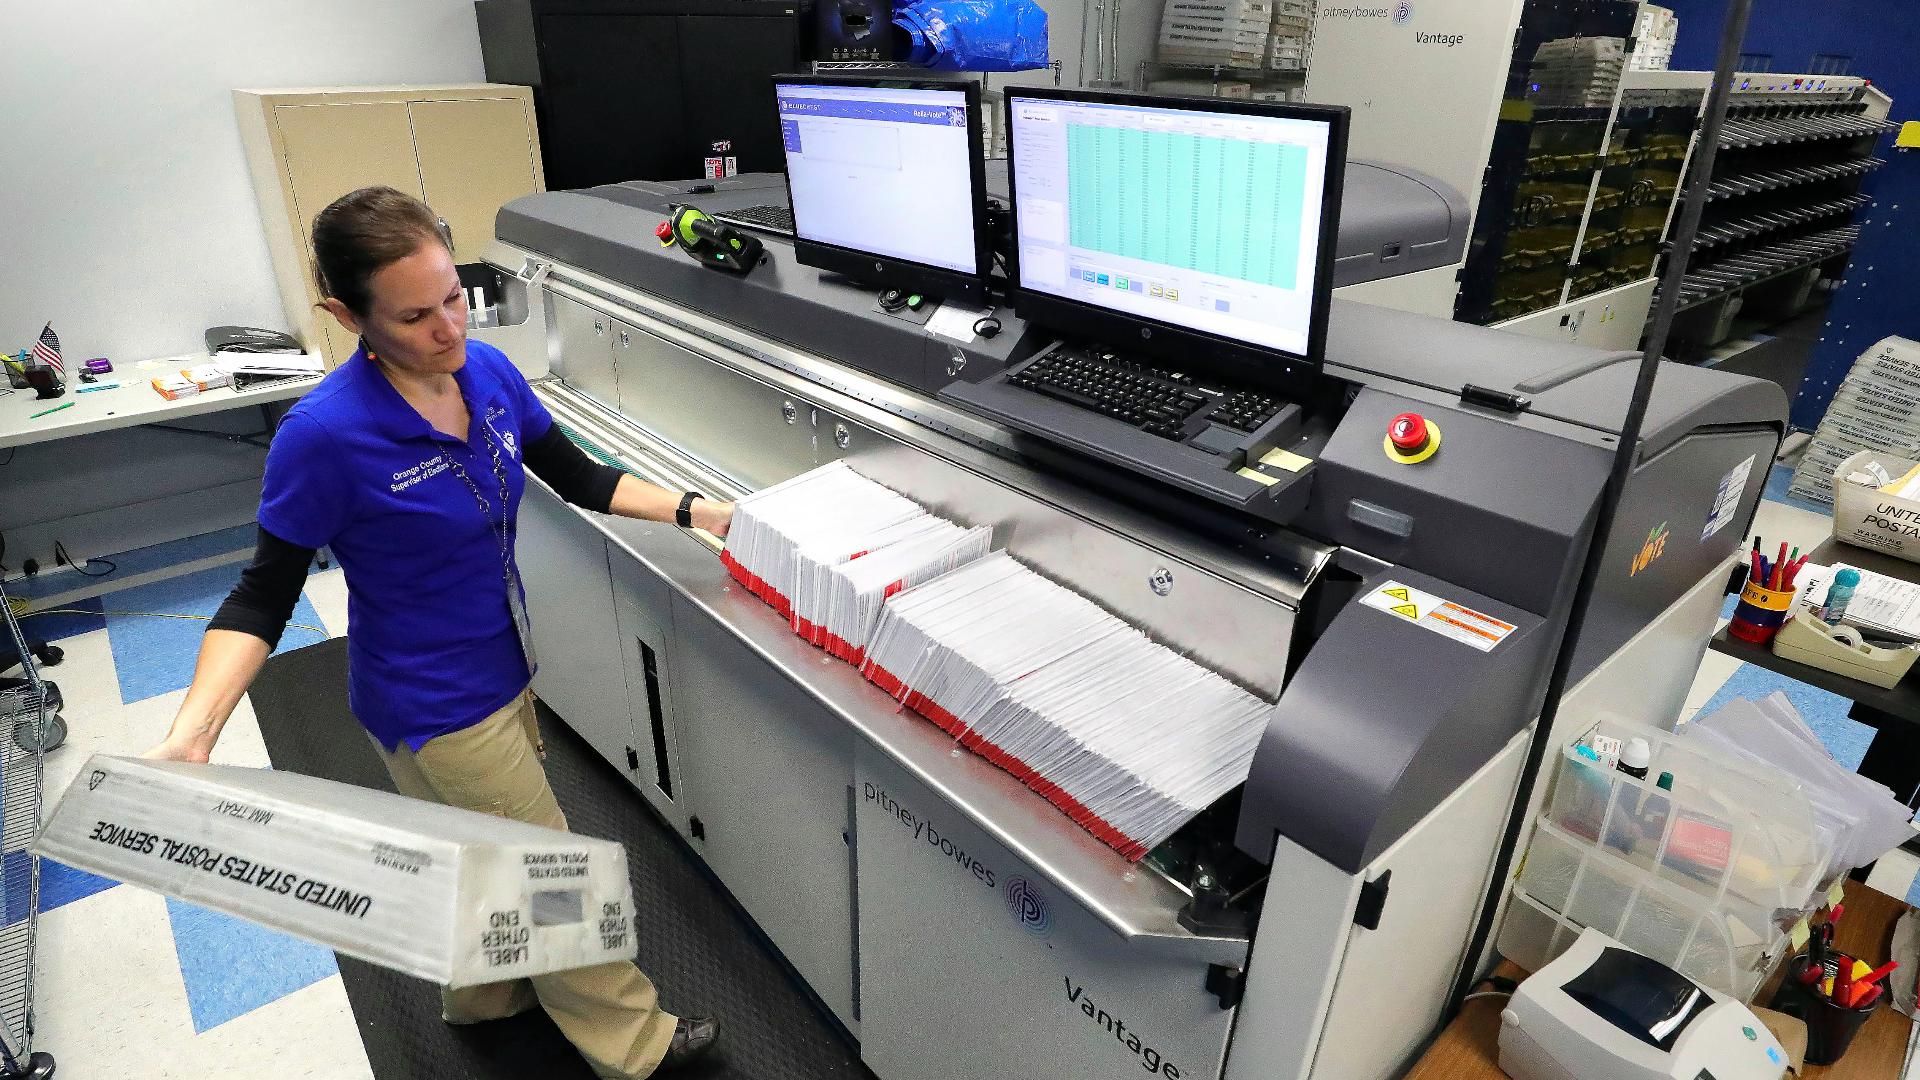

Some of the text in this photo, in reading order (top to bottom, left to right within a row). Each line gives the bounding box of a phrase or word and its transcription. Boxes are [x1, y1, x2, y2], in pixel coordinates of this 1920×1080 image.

[1415, 31, 1464, 48] Vantage
[1876, 361, 1904, 372] STATES
[1877, 354, 1909, 367] SERVICE
[1884, 404, 1912, 416] UNITED
[1888, 396, 1916, 407] UNITED
[1838, 447, 1854, 456] OSTAL
[393, 455, 442, 480] Orange County
[391, 475, 421, 492] Supervisor
[1877, 503, 1920, 524] UNITE
[1863, 515, 1920, 539] POSTA
[1857, 529, 1902, 545] WARNING
[1630, 526, 1670, 577] VOTE
[211, 800, 275, 825] MM TRAY
[89, 820, 373, 920] UNITED STATES POSTAL SERVICE
[489, 910, 520, 928] END
[481, 927, 529, 948] OTHER
[483, 945, 529, 968] LABEL
[1064, 976, 1180, 1080] Vantage
